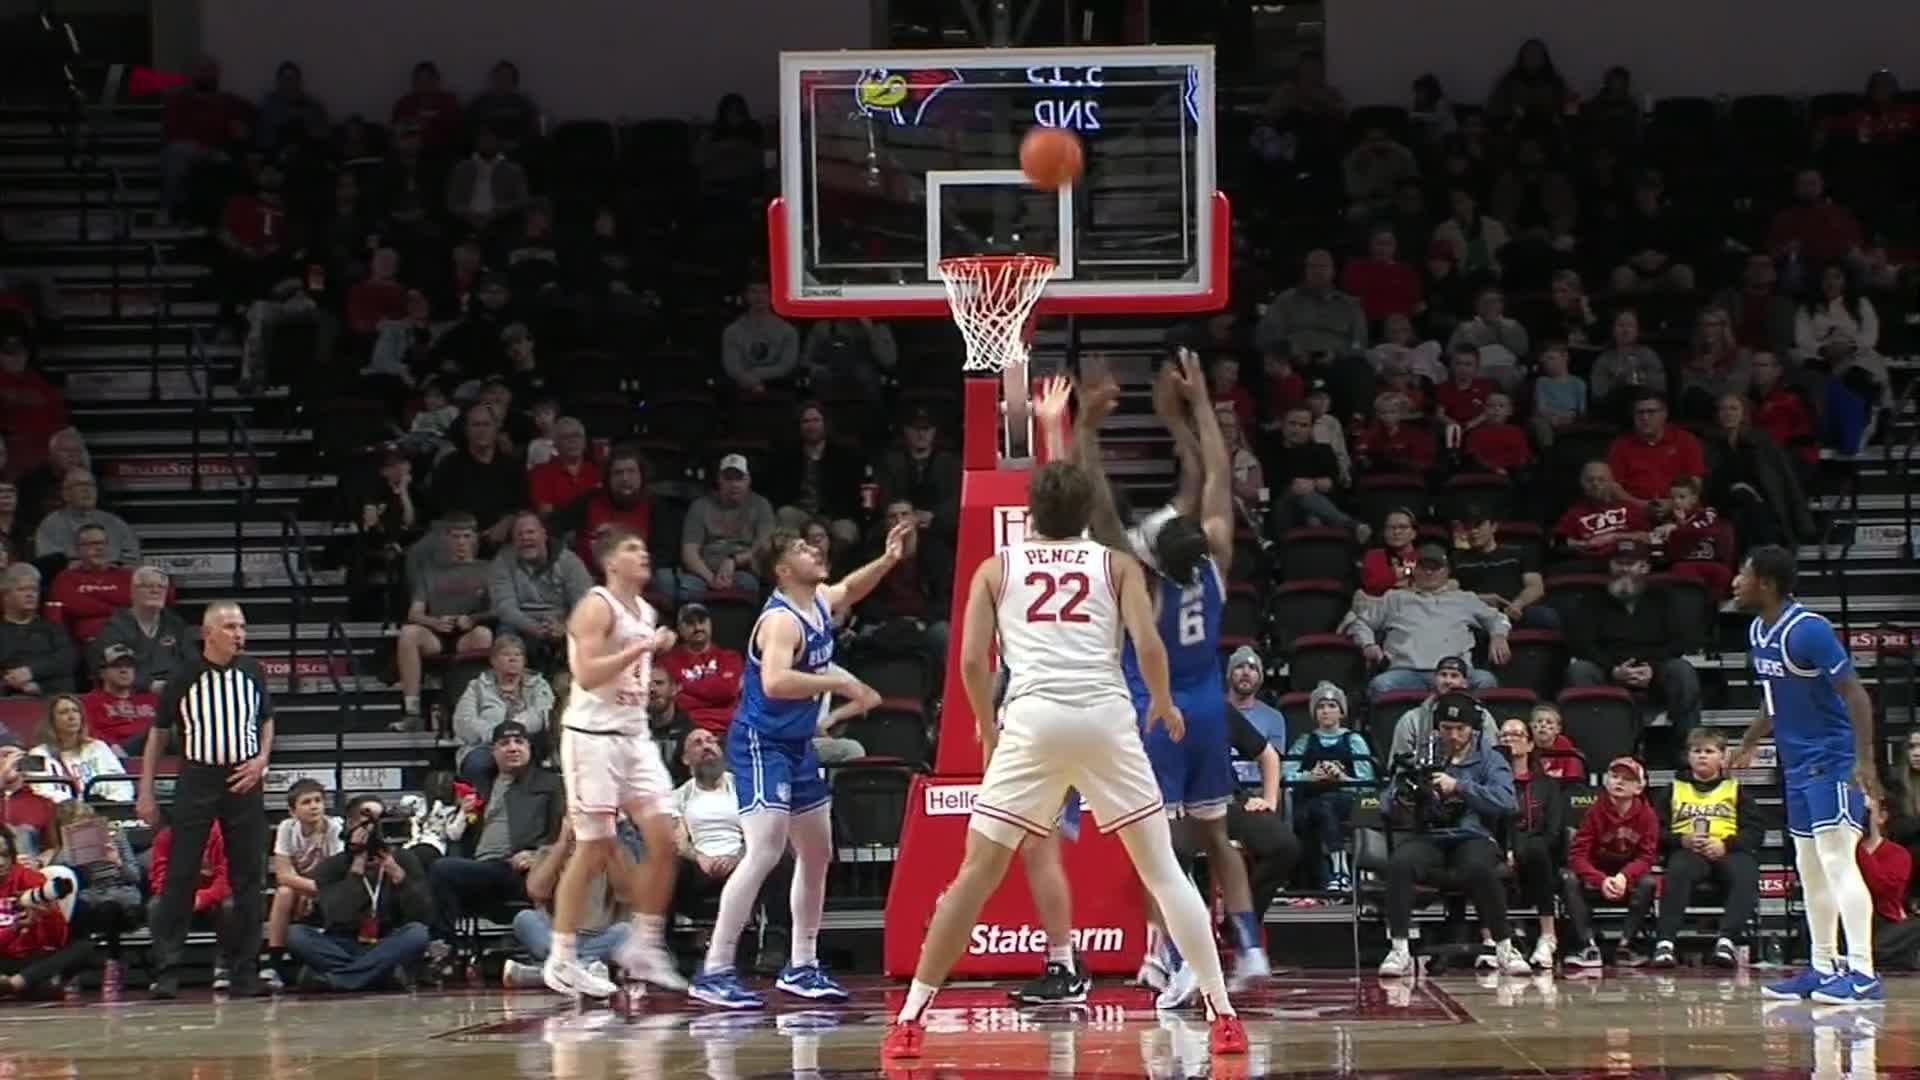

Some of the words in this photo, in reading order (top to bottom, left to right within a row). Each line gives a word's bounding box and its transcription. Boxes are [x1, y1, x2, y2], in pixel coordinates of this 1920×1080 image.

[1025, 548, 1089, 565] PENCE
[1024, 571, 1091, 624] 22
[1179, 601, 1206, 647] 6
[968, 923, 1124, 955] Statearm
